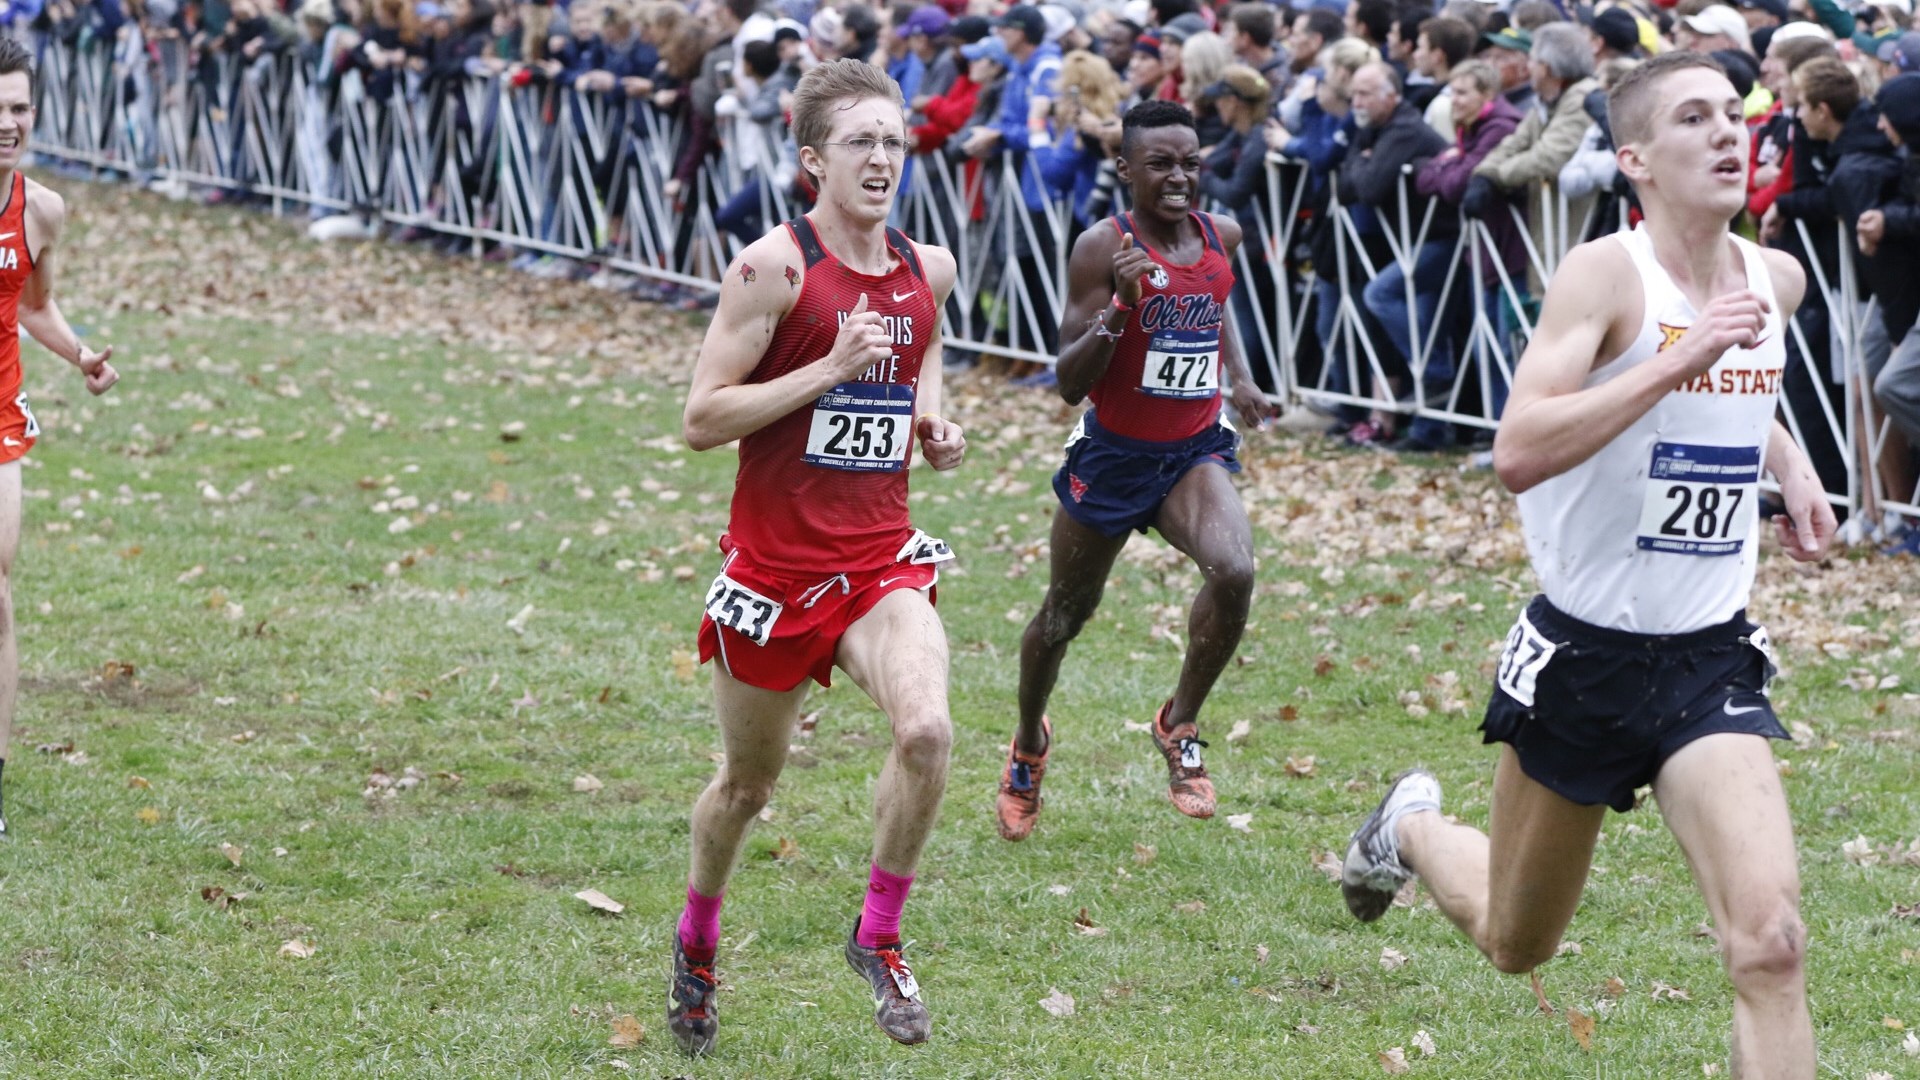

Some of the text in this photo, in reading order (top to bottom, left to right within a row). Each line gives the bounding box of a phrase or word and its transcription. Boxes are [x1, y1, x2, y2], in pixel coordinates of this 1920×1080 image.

[1140, 293, 1222, 330] Ole Mis
[1157, 355, 1209, 388] 472
[823, 414, 896, 459] 253
[1660, 485, 1744, 539] 287
[706, 579, 773, 641] 253
